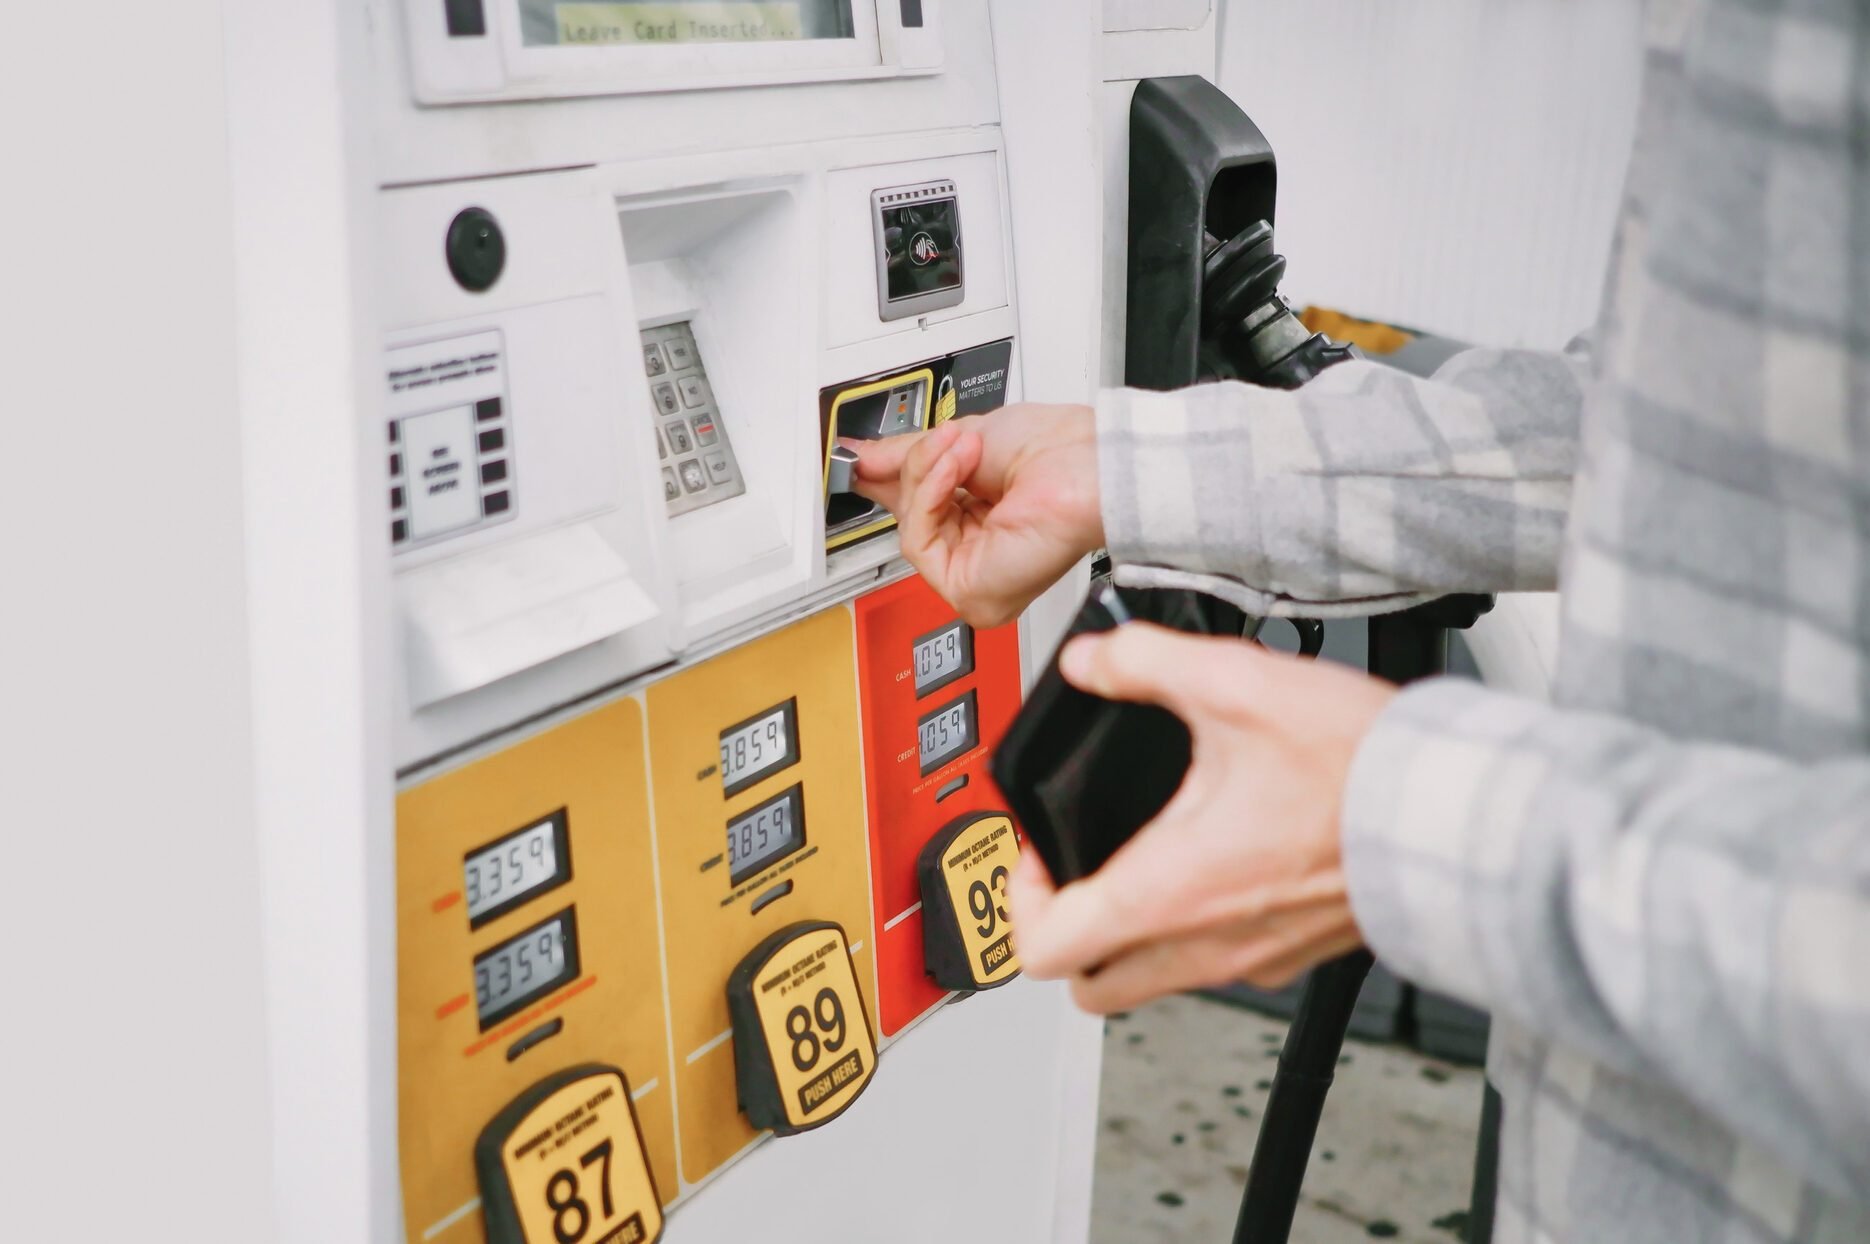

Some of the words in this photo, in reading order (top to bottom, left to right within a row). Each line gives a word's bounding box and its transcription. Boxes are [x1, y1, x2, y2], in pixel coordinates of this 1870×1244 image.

[564, 22, 621, 42] Leave
[634, 20, 678, 40] Card
[960, 376, 977, 389] YOUR
[977, 368, 1005, 385] SECURITY
[958, 385, 985, 401] MATTERS
[985, 383, 994, 393] TO
[895, 668, 912, 682] CASH
[897, 748, 916, 763] CREDIT
[971, 835, 991, 854] OCTANE
[990, 825, 1008, 842] RATING
[968, 865, 1010, 939] 93
[985, 942, 1008, 968] PUSH
[786, 986, 847, 1072] 89
[804, 1074, 833, 1108] PUSH
[831, 1055, 860, 1087] HERE
[546, 1135, 615, 1244] 87
